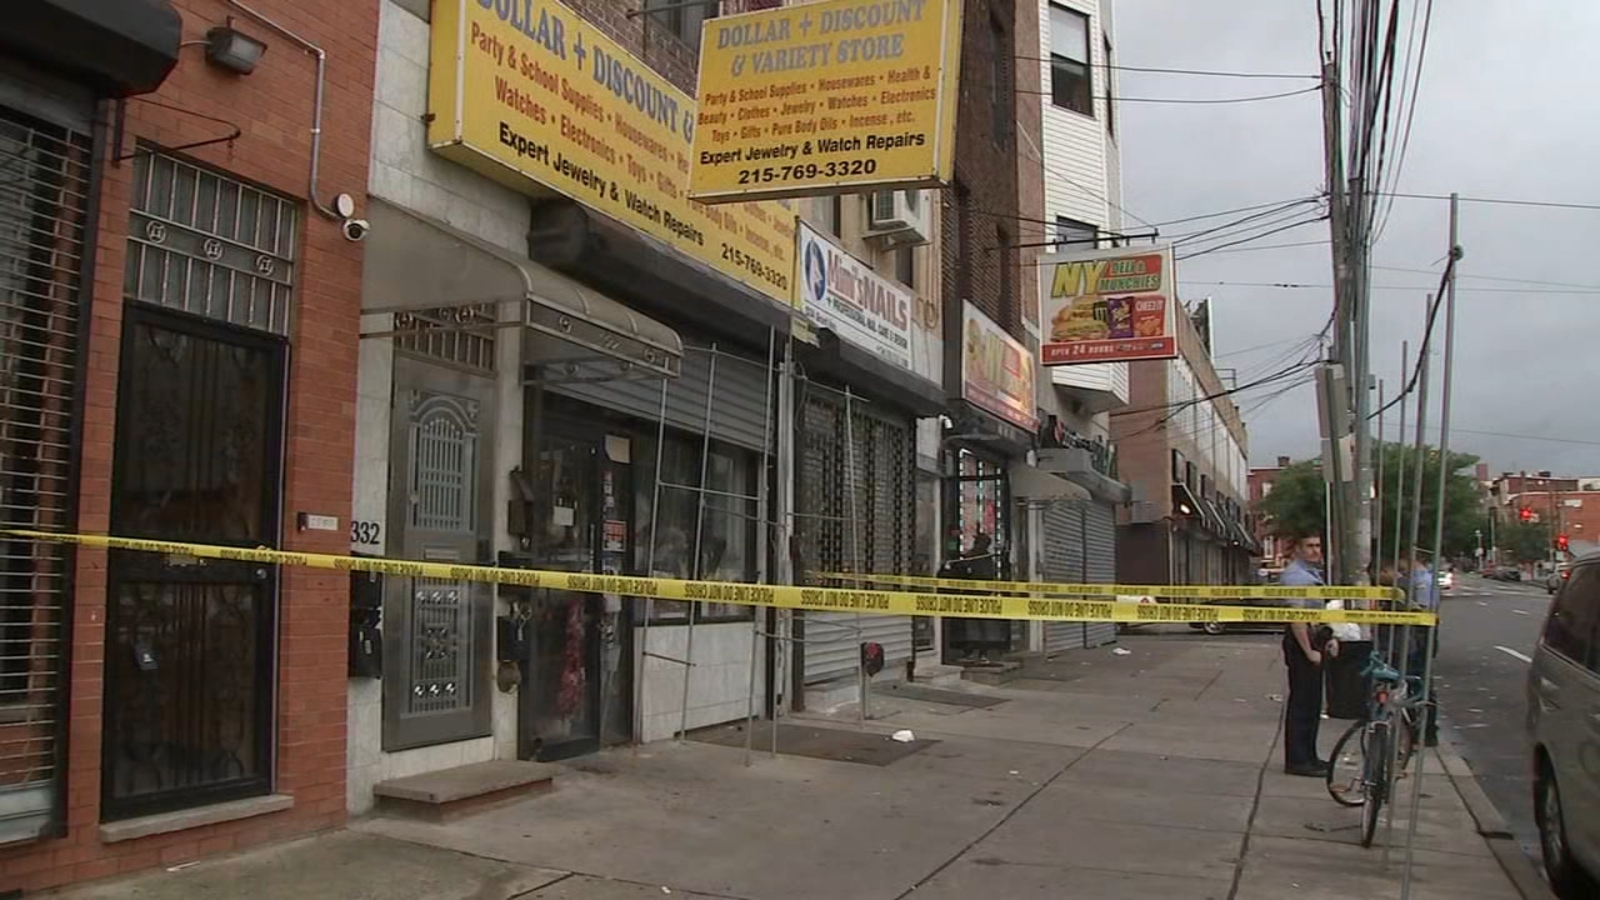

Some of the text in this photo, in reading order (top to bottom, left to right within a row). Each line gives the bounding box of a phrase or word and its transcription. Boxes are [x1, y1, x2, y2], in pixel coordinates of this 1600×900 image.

[718, 18, 791, 50] DOLLAR
[819, 0, 926, 34] DISCOUNT
[471, 21, 504, 66] Party
[508, 45, 517, 70] &
[520, 53, 559, 96] School
[561, 78, 604, 122] Supplies
[477, 0, 568, 60] OLLAR
[593, 45, 678, 132] DISCOUNT
[752, 42, 832, 74] VARIETY
[837, 33, 905, 64] STORE
[705, 65, 931, 107] Party & School Supplies Housewares Health &
[495, 75, 547, 125] Watches
[561, 114, 615, 165] Electronics
[698, 86, 936, 126] Beauty Clothes Jewelry Watches Electronics
[712, 129, 730, 145] Toys
[741, 125, 761, 140] Gifts
[772, 122, 793, 136] Pure
[795, 118, 817, 135] Body
[820, 116, 837, 131] Oils
[700, 131, 925, 168] Expert Jewelry & Watch Repairs
[738, 158, 877, 185] 215-769-3320
[499, 121, 549, 166] Expert
[553, 152, 606, 198] Jewelry
[610, 182, 620, 202] &
[625, 189, 661, 224] Watch
[664, 210, 704, 246] Repairs
[721, 243, 788, 291] 215-769-3320
[1051, 260, 1107, 298] NY
[1100, 273, 1161, 292] MUNCHIES
[863, 274, 908, 332] NAILS
[1072, 344, 1087, 356] 24
[350, 520, 380, 545] 332
[567, 575, 658, 596] POLICE LINE DO NOT CROSS
[685, 583, 774, 603] POLICE LINE DO NOT CROSS
[801, 590, 889, 609] POLICE LINE DO NOT CROSS
[916, 596, 1002, 615] POLICE LINE DO NOT CROSS
[1028, 600, 1112, 618] POLICE LINE DO NOT CROSS
